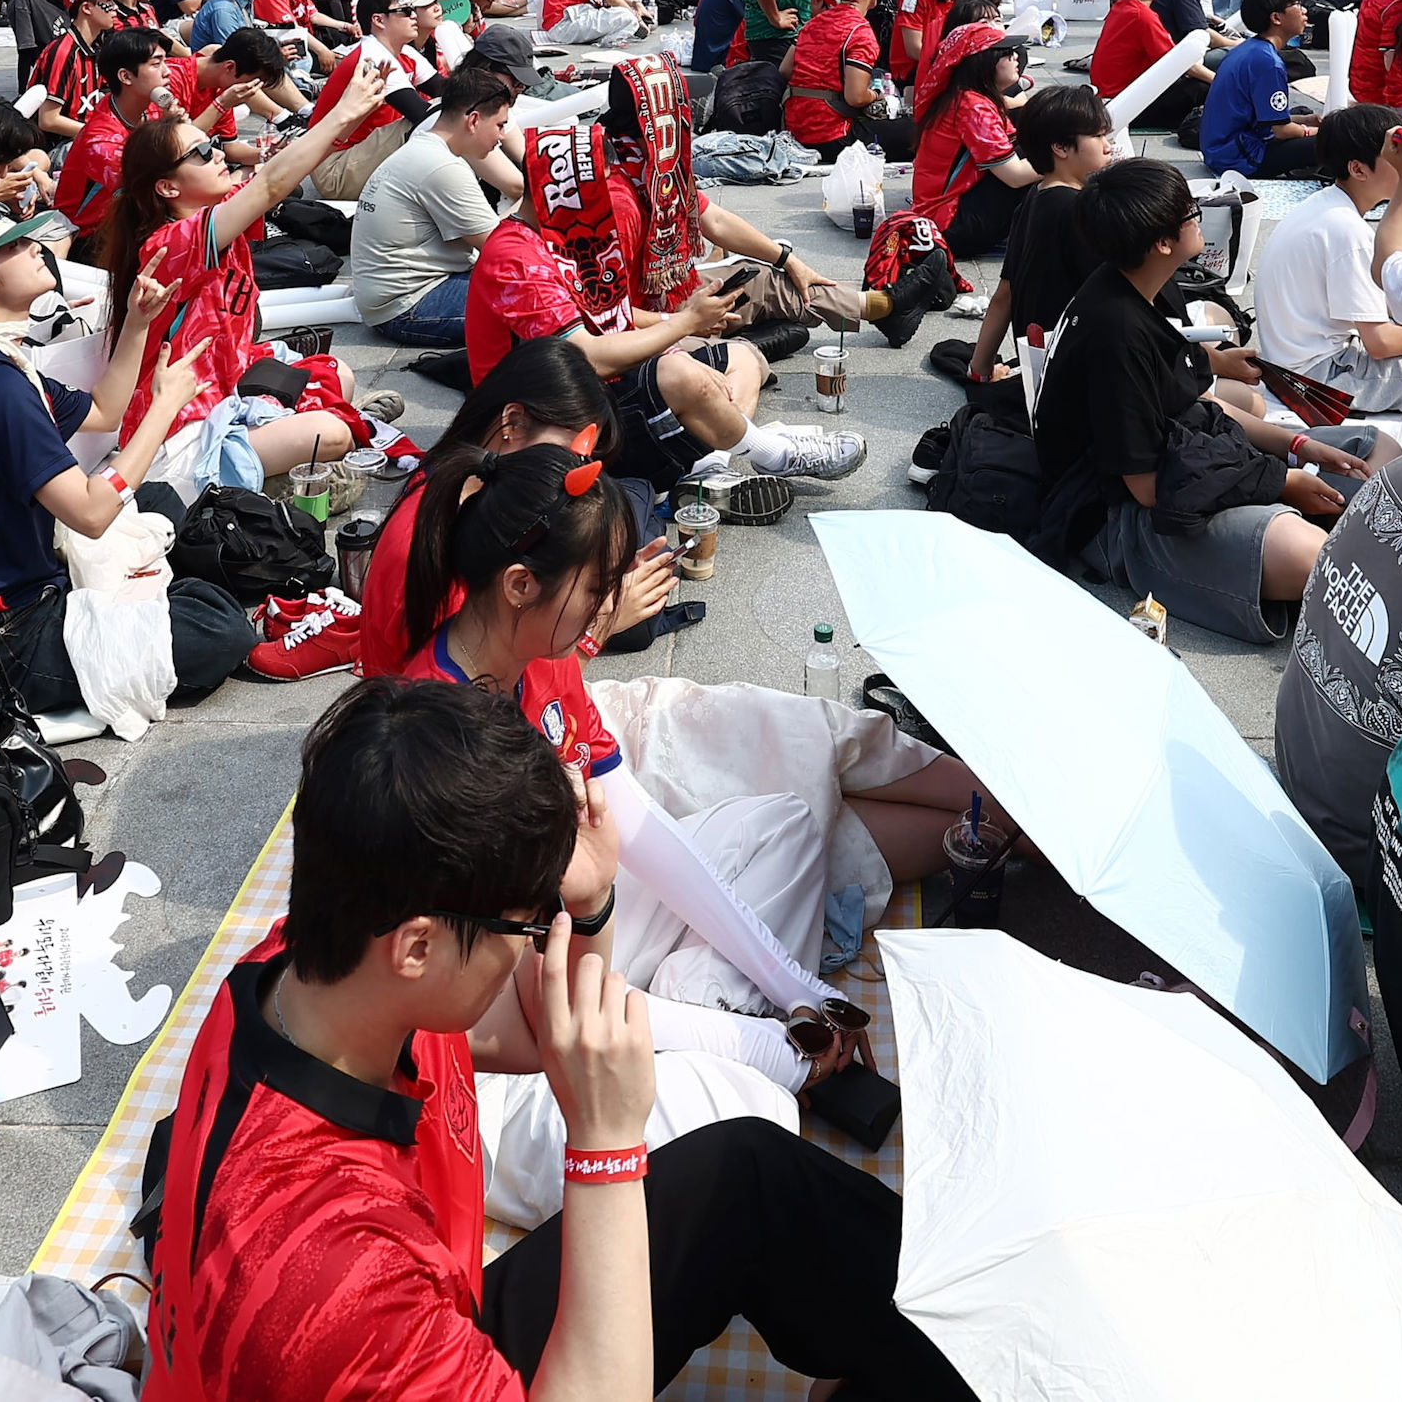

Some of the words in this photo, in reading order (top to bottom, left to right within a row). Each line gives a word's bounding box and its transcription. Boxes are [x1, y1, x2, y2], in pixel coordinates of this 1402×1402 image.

[219, 268, 254, 316] 18
[1321, 555, 1367, 622] NORTH
[1347, 562, 1376, 599] THE
[1323, 587, 1355, 637] FACE
